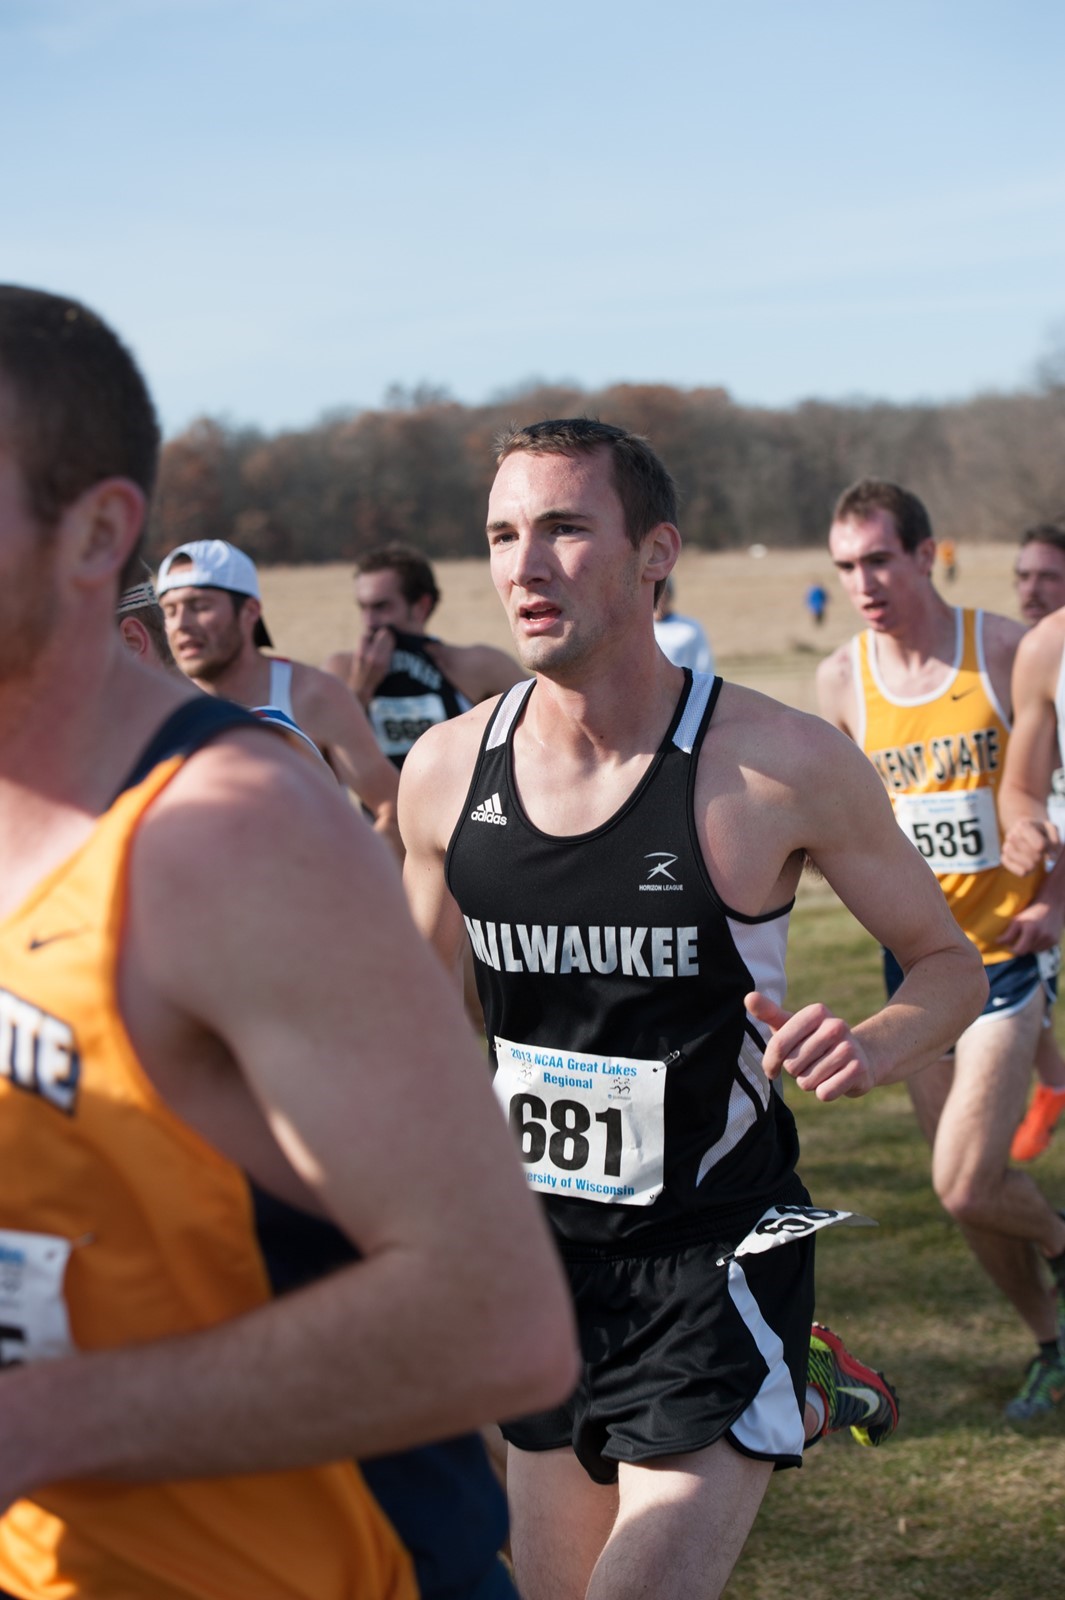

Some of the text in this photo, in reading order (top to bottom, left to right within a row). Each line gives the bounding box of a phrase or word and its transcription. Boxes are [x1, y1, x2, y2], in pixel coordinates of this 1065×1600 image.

[931, 727, 1000, 782] STATE
[470, 809, 508, 826] adidas
[912, 818, 984, 858] 535
[510, 1048, 637, 1077] 2013 NCAA Great Lakes
[543, 1072, 593, 1090] Regional
[508, 1093, 623, 1178] 681
[560, 1178, 572, 1189] of
[575, 1179, 635, 1196] Wisconsin
